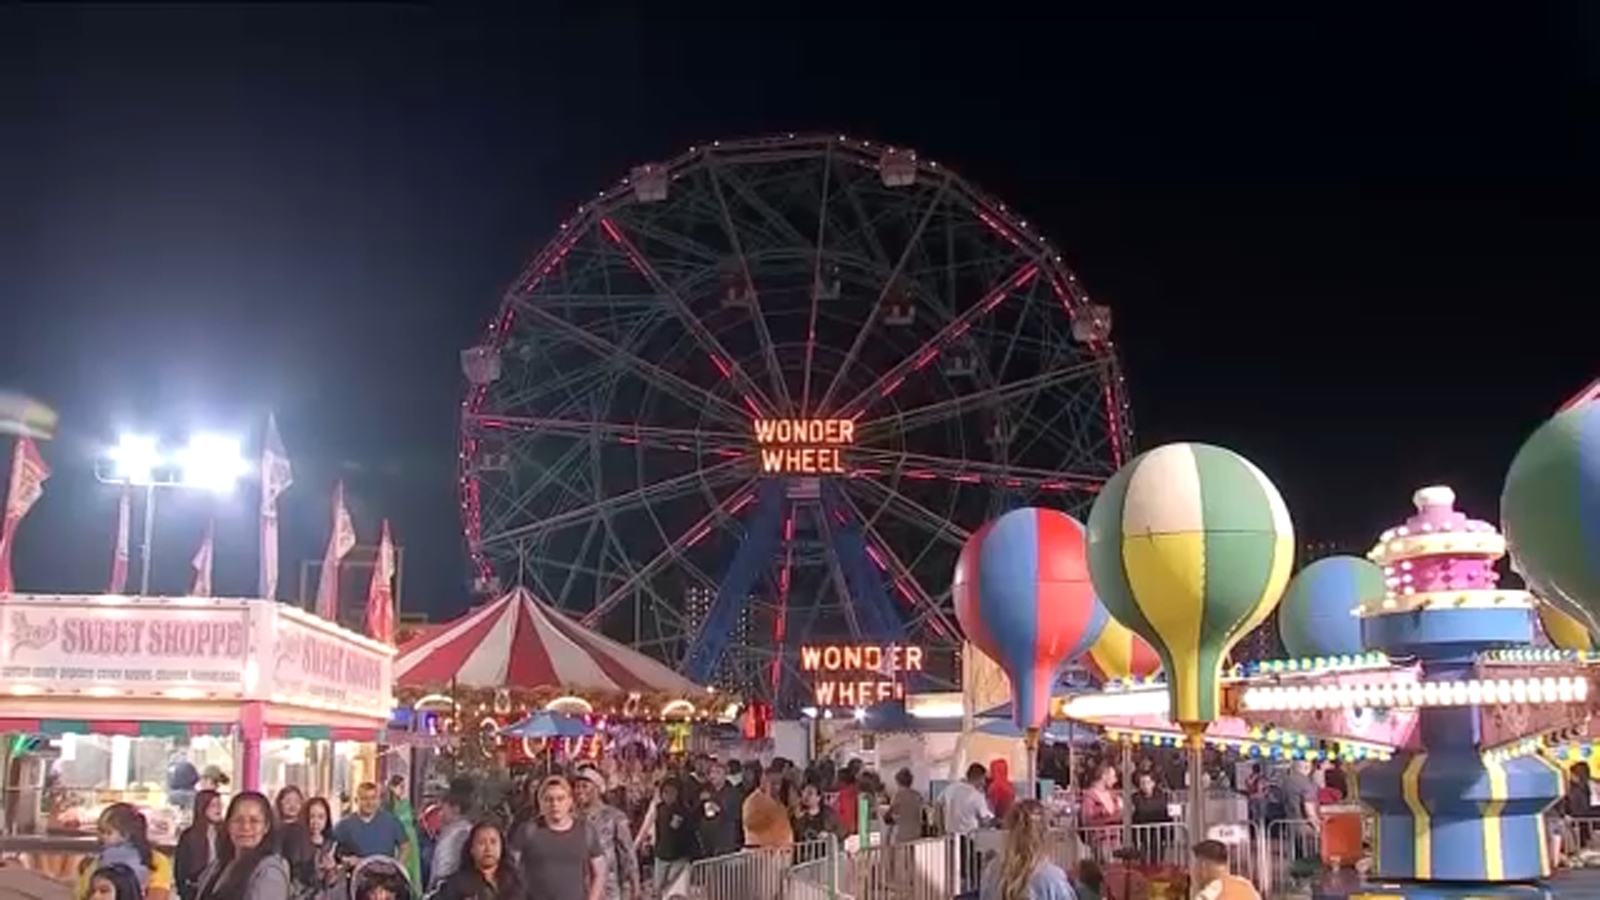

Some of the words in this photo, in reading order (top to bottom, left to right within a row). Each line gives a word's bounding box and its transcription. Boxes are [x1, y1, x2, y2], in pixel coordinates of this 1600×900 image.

[754, 419, 854, 443] WONDER
[761, 448, 845, 473] WHEEL
[61, 617, 146, 655] SWEET
[149, 619, 243, 659] SHOPPE
[801, 645, 923, 671] WONDER
